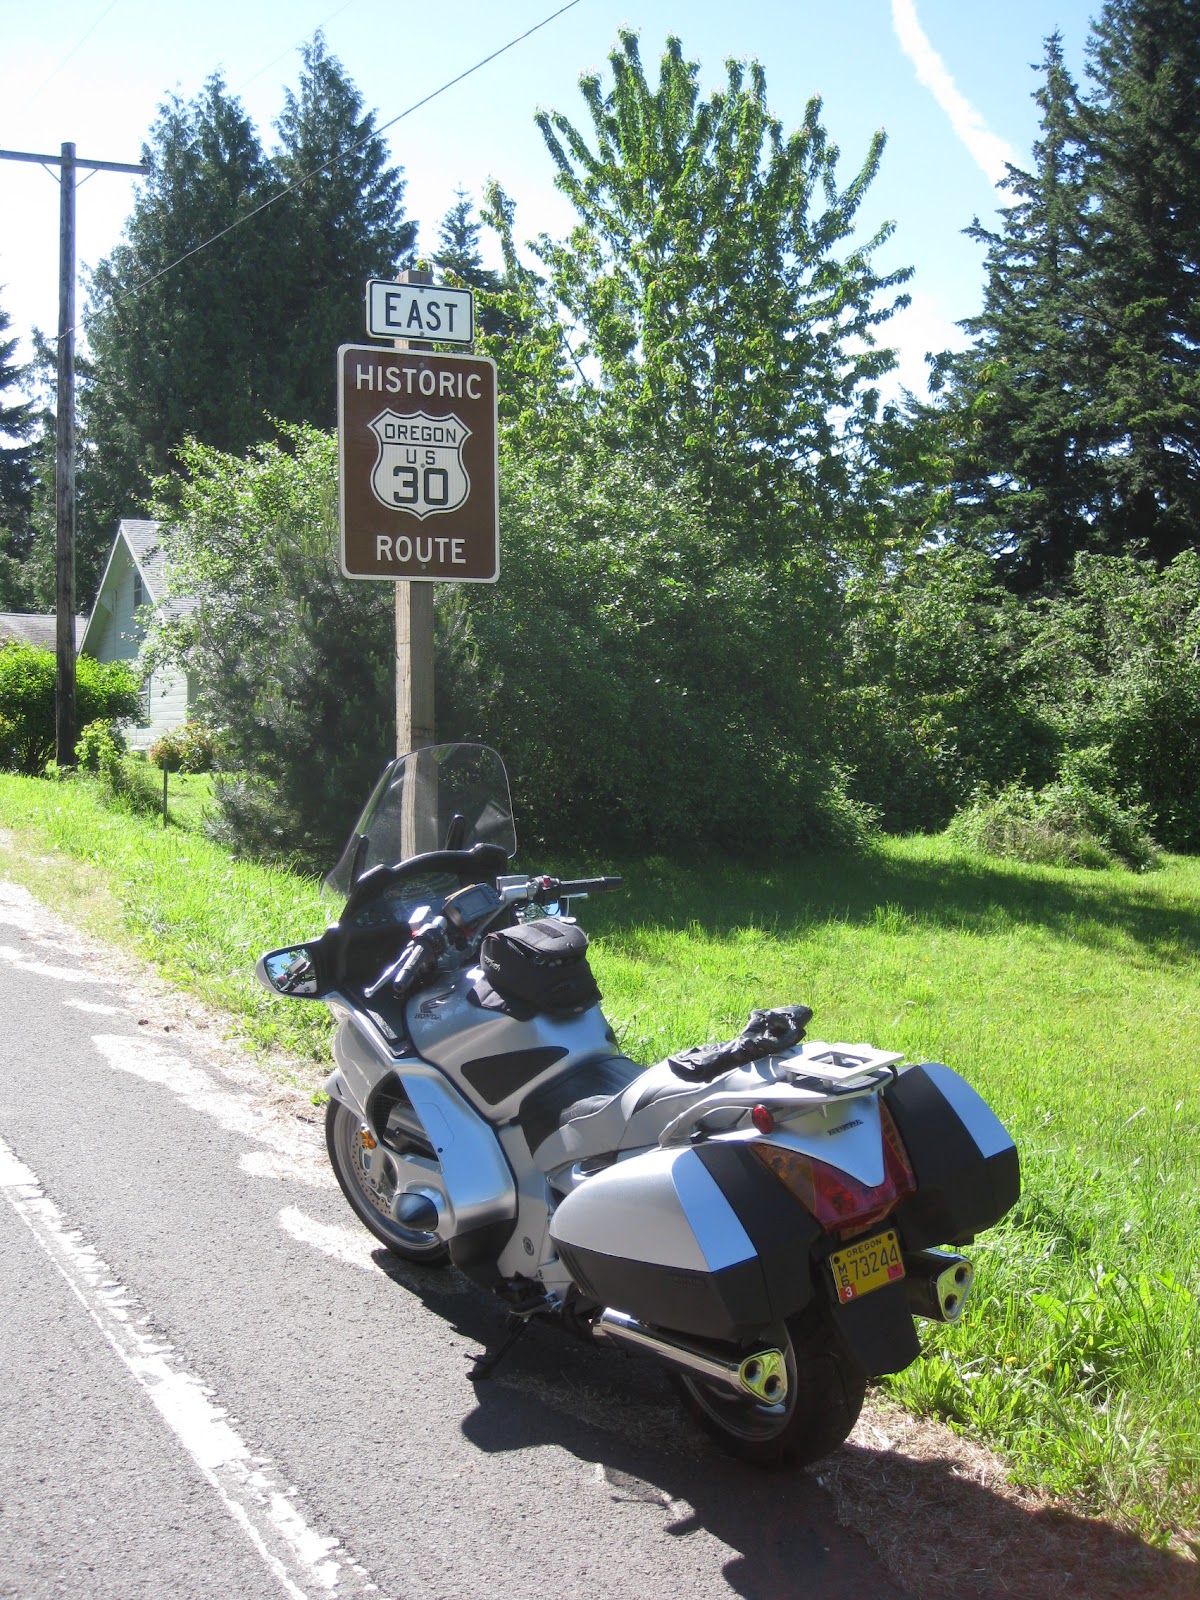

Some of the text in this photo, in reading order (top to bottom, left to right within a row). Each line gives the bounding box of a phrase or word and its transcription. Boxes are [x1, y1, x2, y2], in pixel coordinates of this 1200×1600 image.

[385, 292, 458, 333] EAST
[356, 364, 482, 400] HISTORIC
[385, 423, 457, 444] OREGON
[393, 465, 449, 506] 30
[376, 535, 467, 564] ROUTE
[846, 1238, 882, 1258] OREGON
[850, 1243, 899, 1280] 73244
